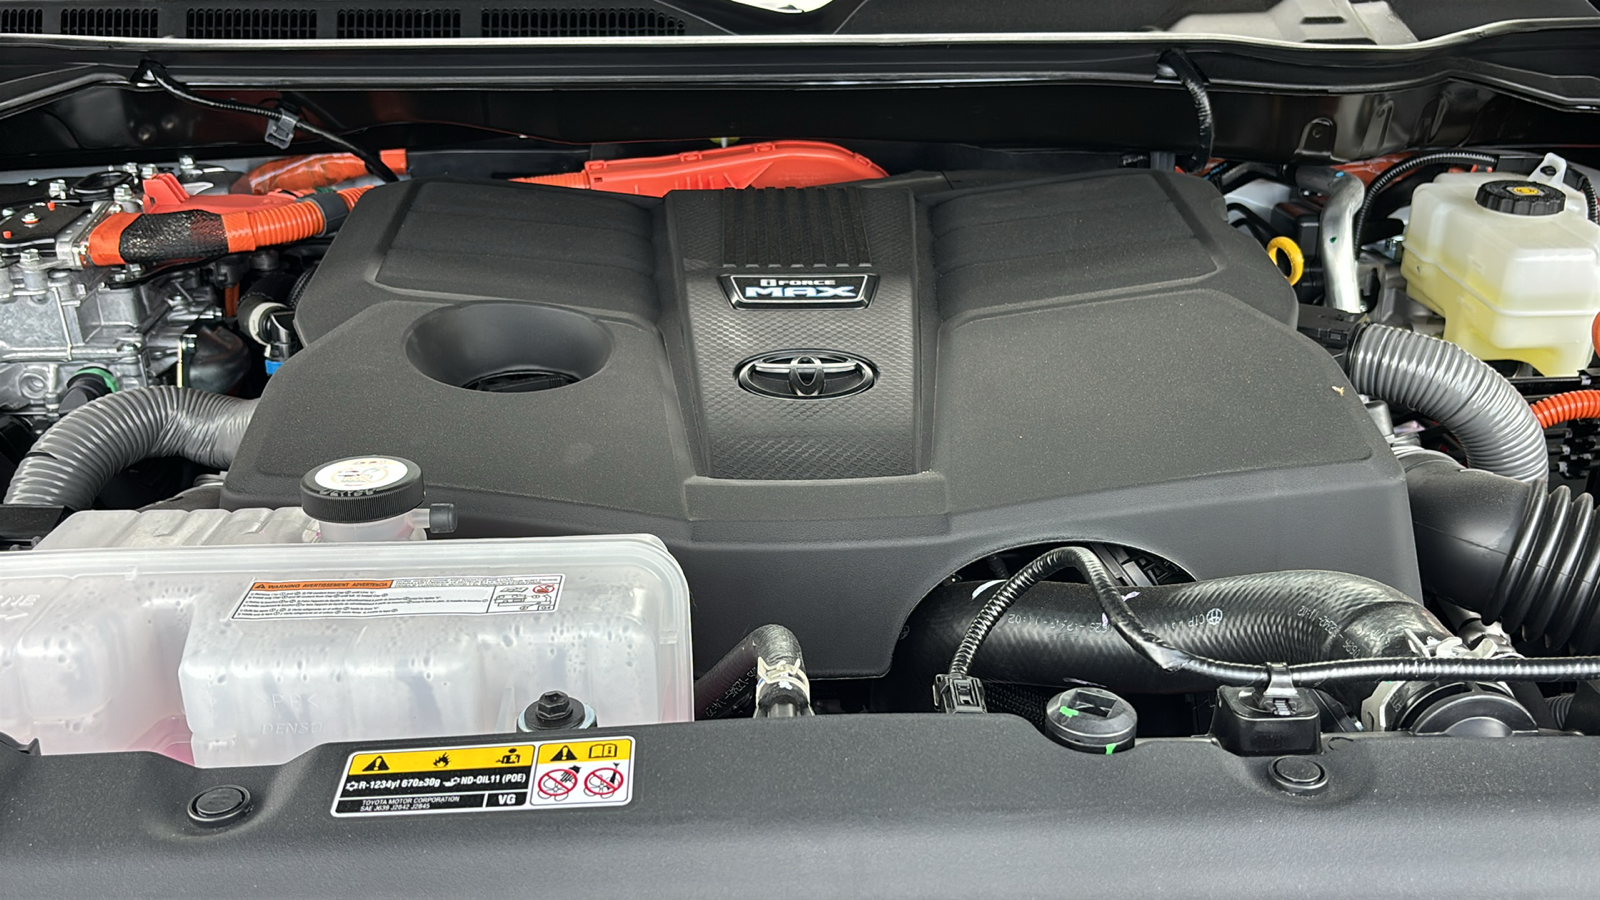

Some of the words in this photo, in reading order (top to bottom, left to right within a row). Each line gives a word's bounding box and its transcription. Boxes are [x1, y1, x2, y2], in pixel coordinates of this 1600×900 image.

[745, 286, 857, 298] MAX
[261, 721, 323, 735] DENSO
[502, 773, 527, 784] (POE)
[413, 796, 460, 805] CORPORATION
[497, 793, 517, 805] VG
